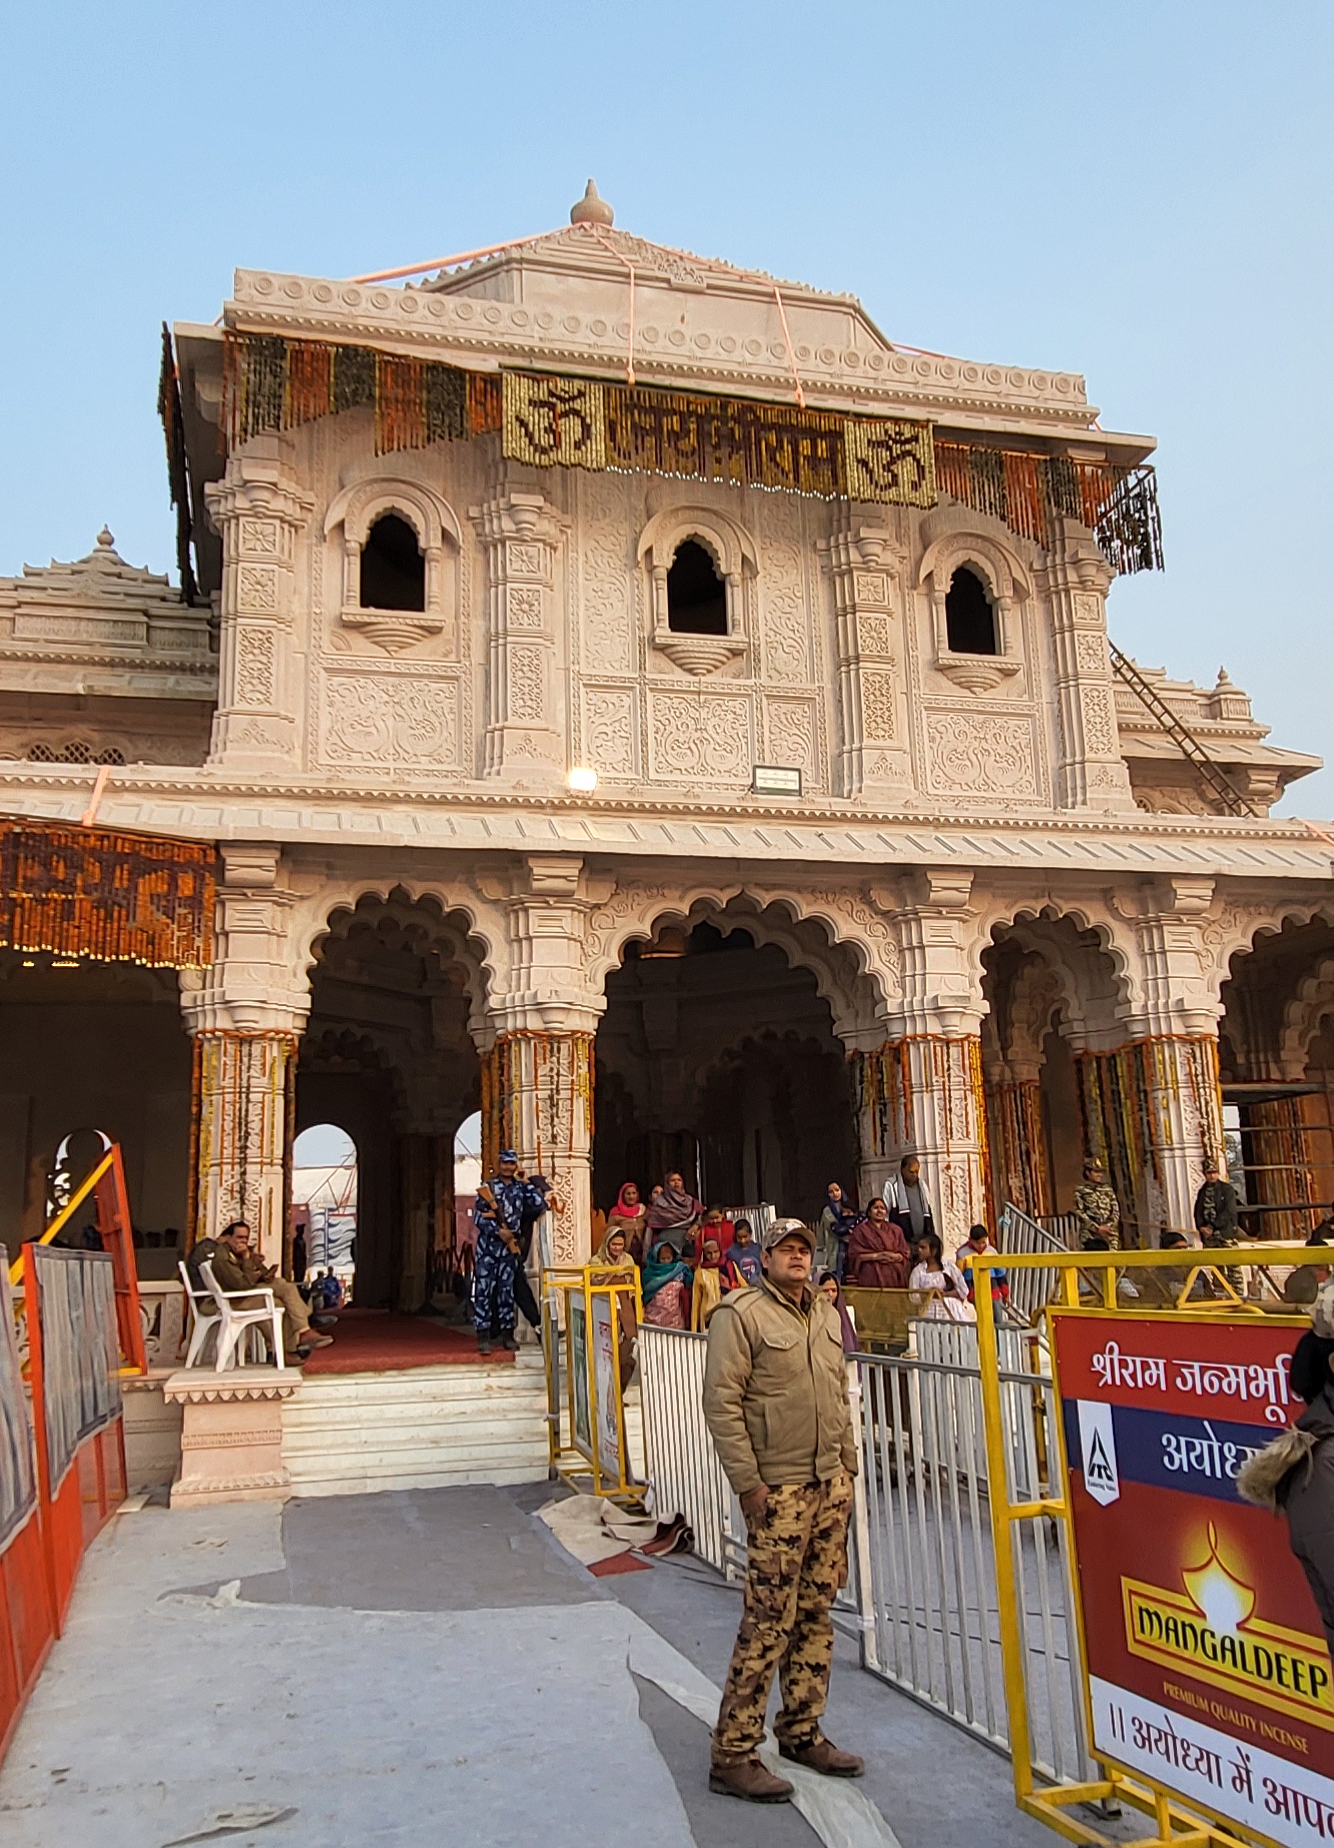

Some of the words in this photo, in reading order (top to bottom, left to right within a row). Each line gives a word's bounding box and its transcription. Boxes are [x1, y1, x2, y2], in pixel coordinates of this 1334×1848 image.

[1091, 1341, 1167, 1391] श्रीराम
[1137, 1604, 1328, 1699] MANGALDEEP
[1163, 1681, 1210, 1714] PREMIUM
[1210, 1699, 1258, 1734] QUALITY
[1260, 1720, 1309, 1754] INCENSE
[1131, 1714, 1223, 1789] अयोध्या
[1227, 1745, 1255, 1804] में
